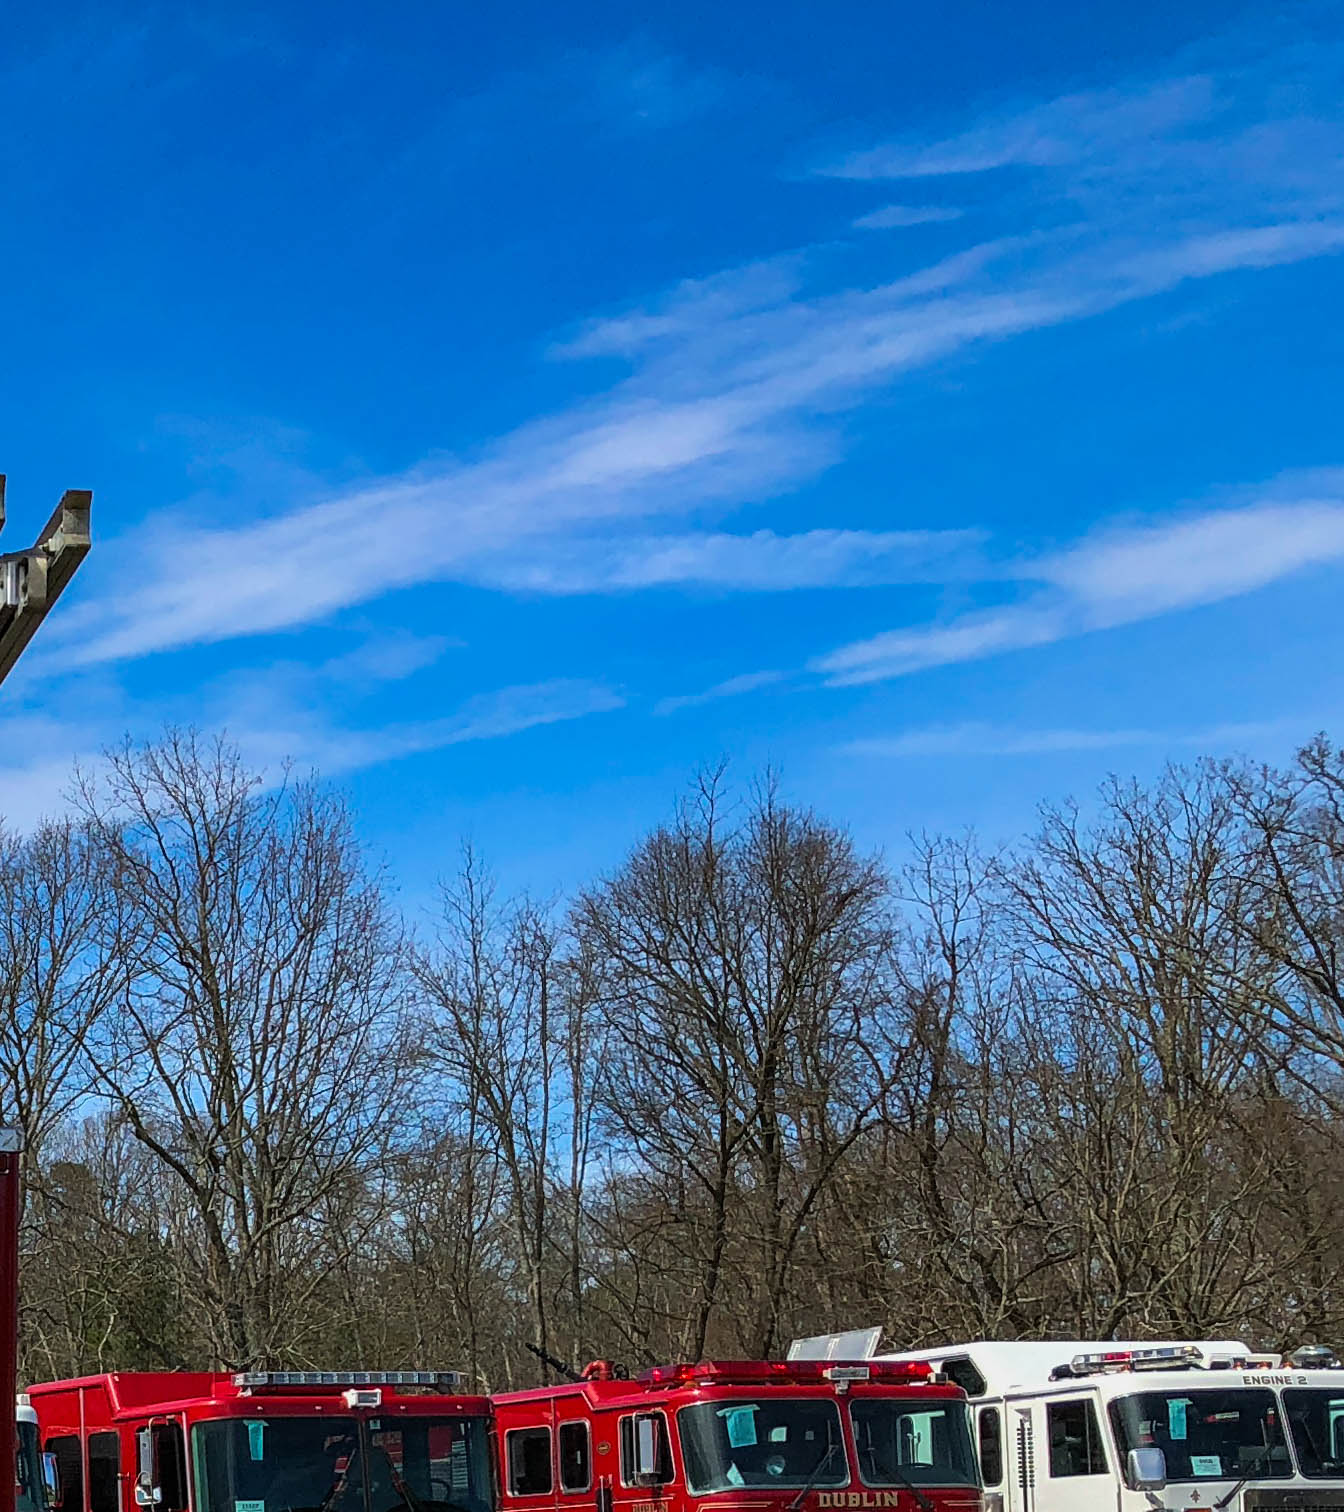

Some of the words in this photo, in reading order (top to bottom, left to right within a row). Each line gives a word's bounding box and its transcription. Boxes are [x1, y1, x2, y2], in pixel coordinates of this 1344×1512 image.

[1243, 1375, 1292, 1385] ENGINE
[1297, 1376, 1308, 1385] 2
[818, 1491, 898, 1507] DUBLIN
